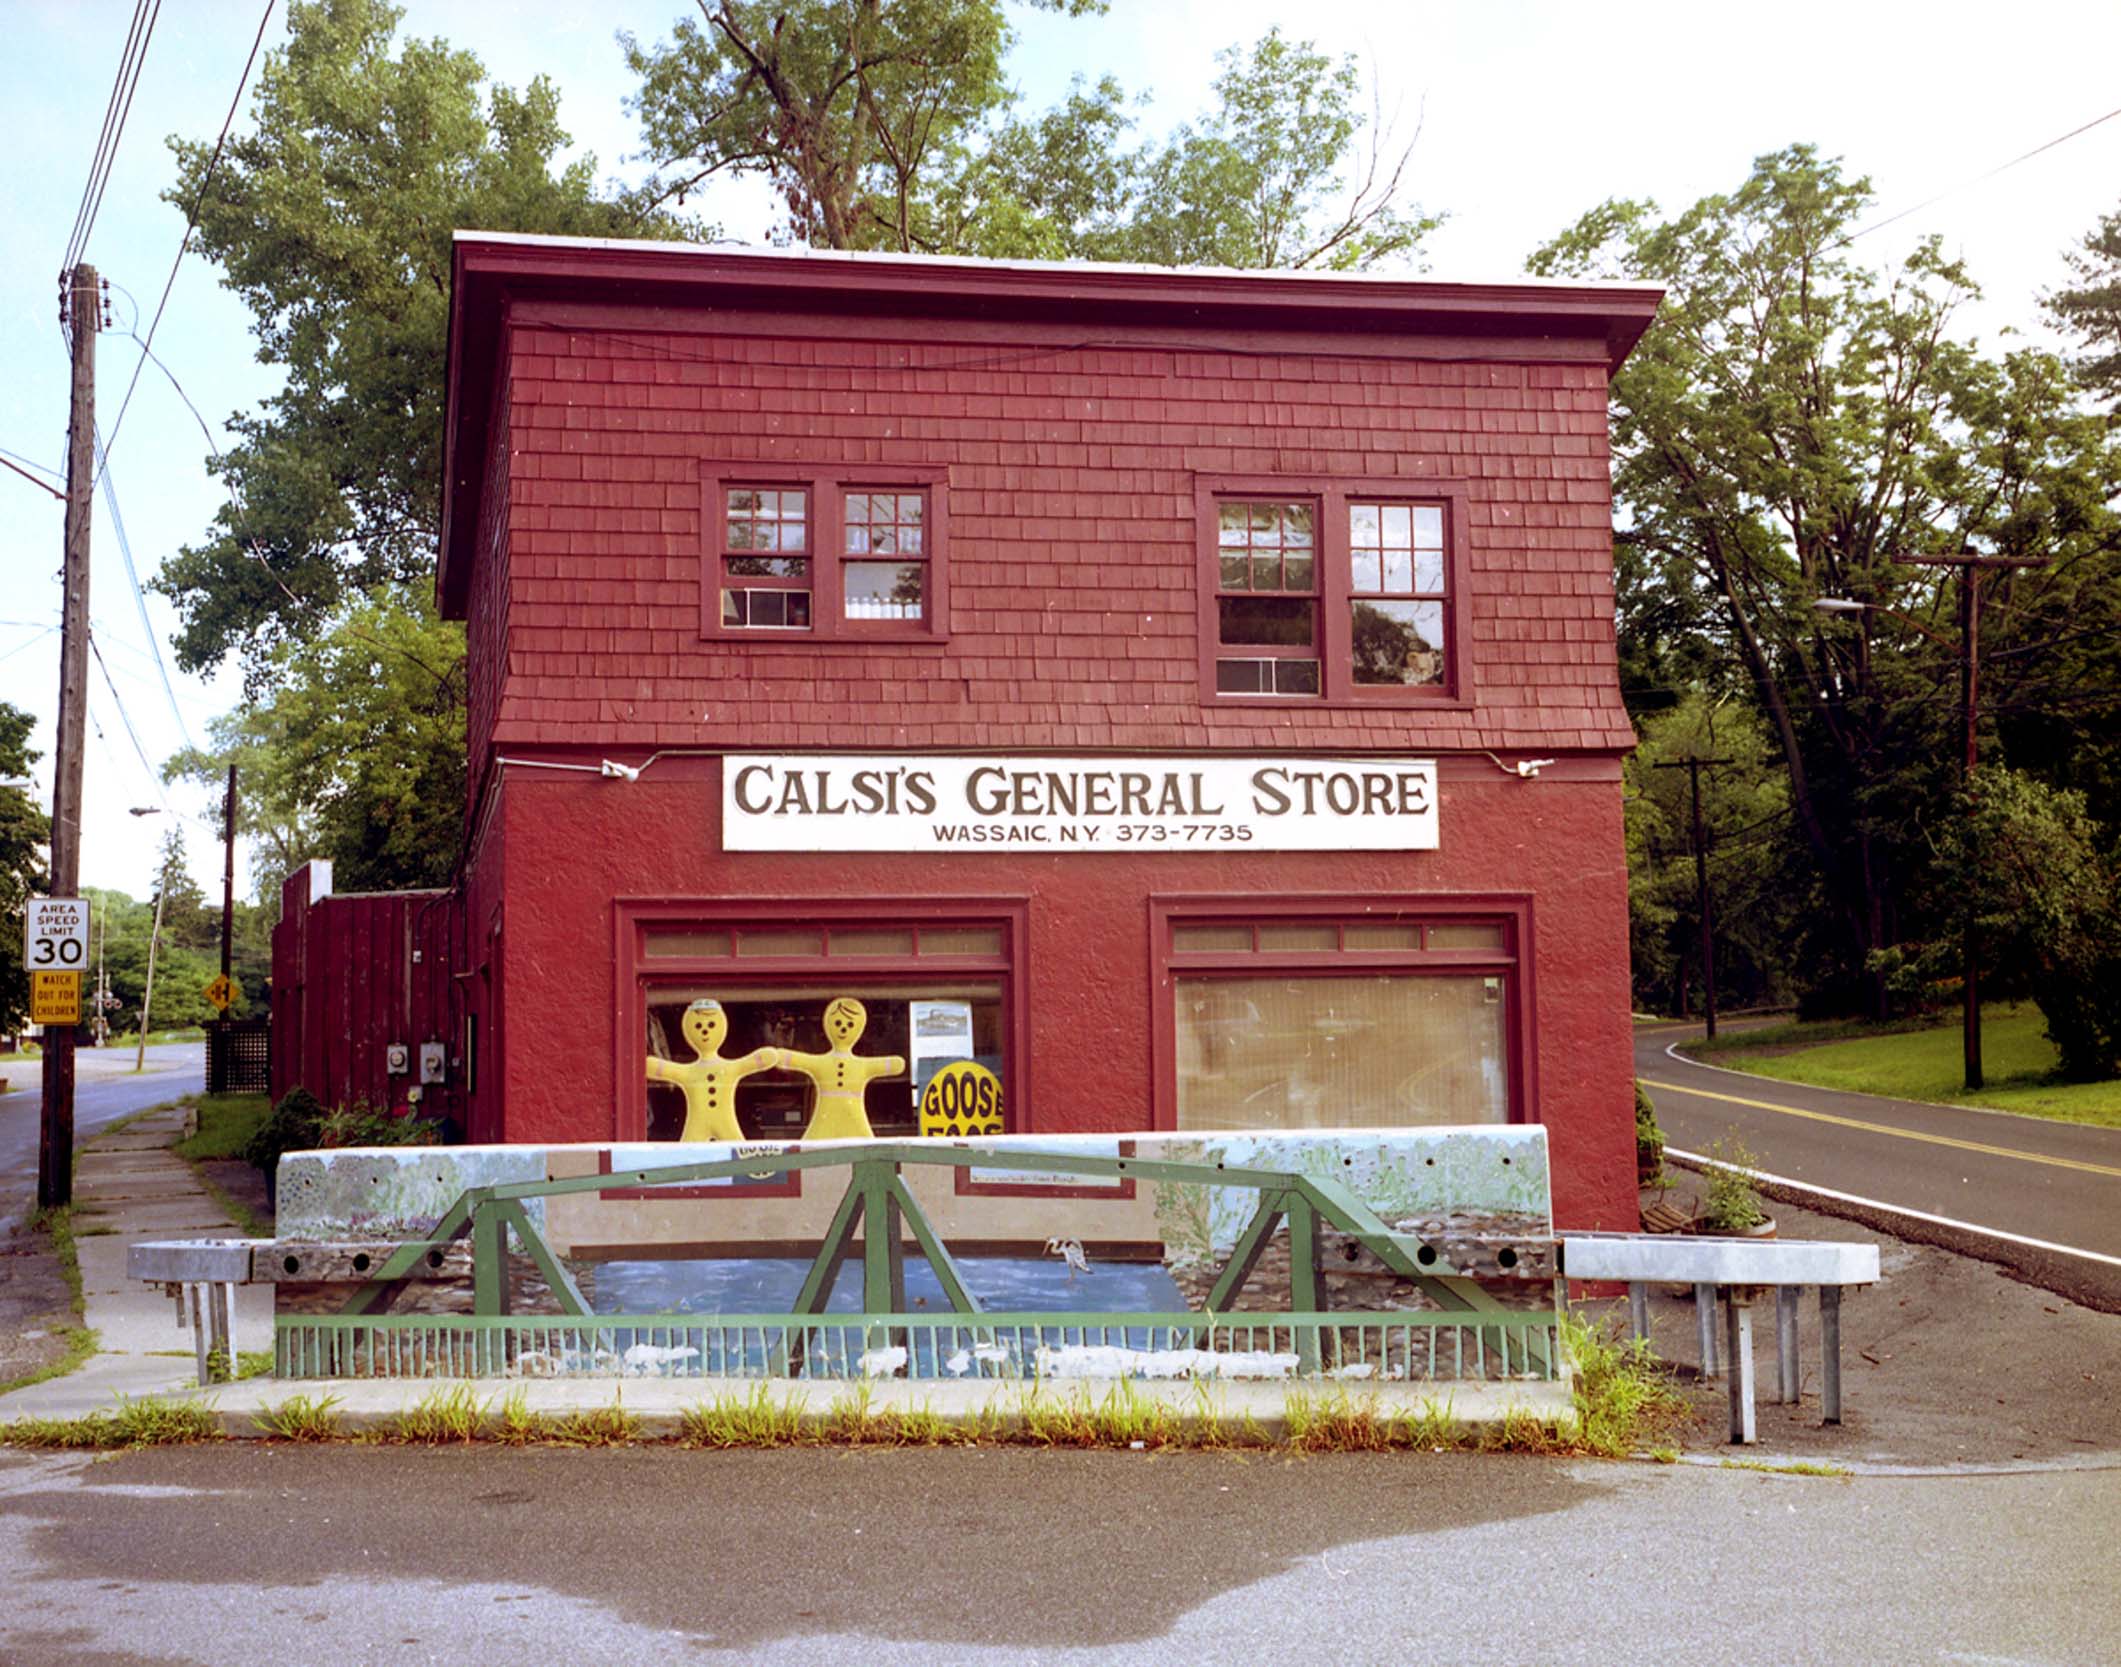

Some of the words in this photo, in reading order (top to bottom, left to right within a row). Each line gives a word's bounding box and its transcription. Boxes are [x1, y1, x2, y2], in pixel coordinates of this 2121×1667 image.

[734, 764, 937, 816] CALSI'S
[965, 765, 1225, 817] GENERAL
[1251, 766, 1430, 817] STORE
[933, 824, 1052, 843] WASSAIC,
[1116, 824, 1253, 842] 373-7735
[40, 904, 77, 914] AREA
[37, 915, 80, 925] SPEED
[41, 926, 75, 936] LIMIT
[33, 938, 82, 964] 30
[42, 975, 72, 985] WATCH
[37, 990, 55, 1000] OUT
[58, 990, 76, 1000] FOR
[36, 1005, 77, 1016] CHILDREN
